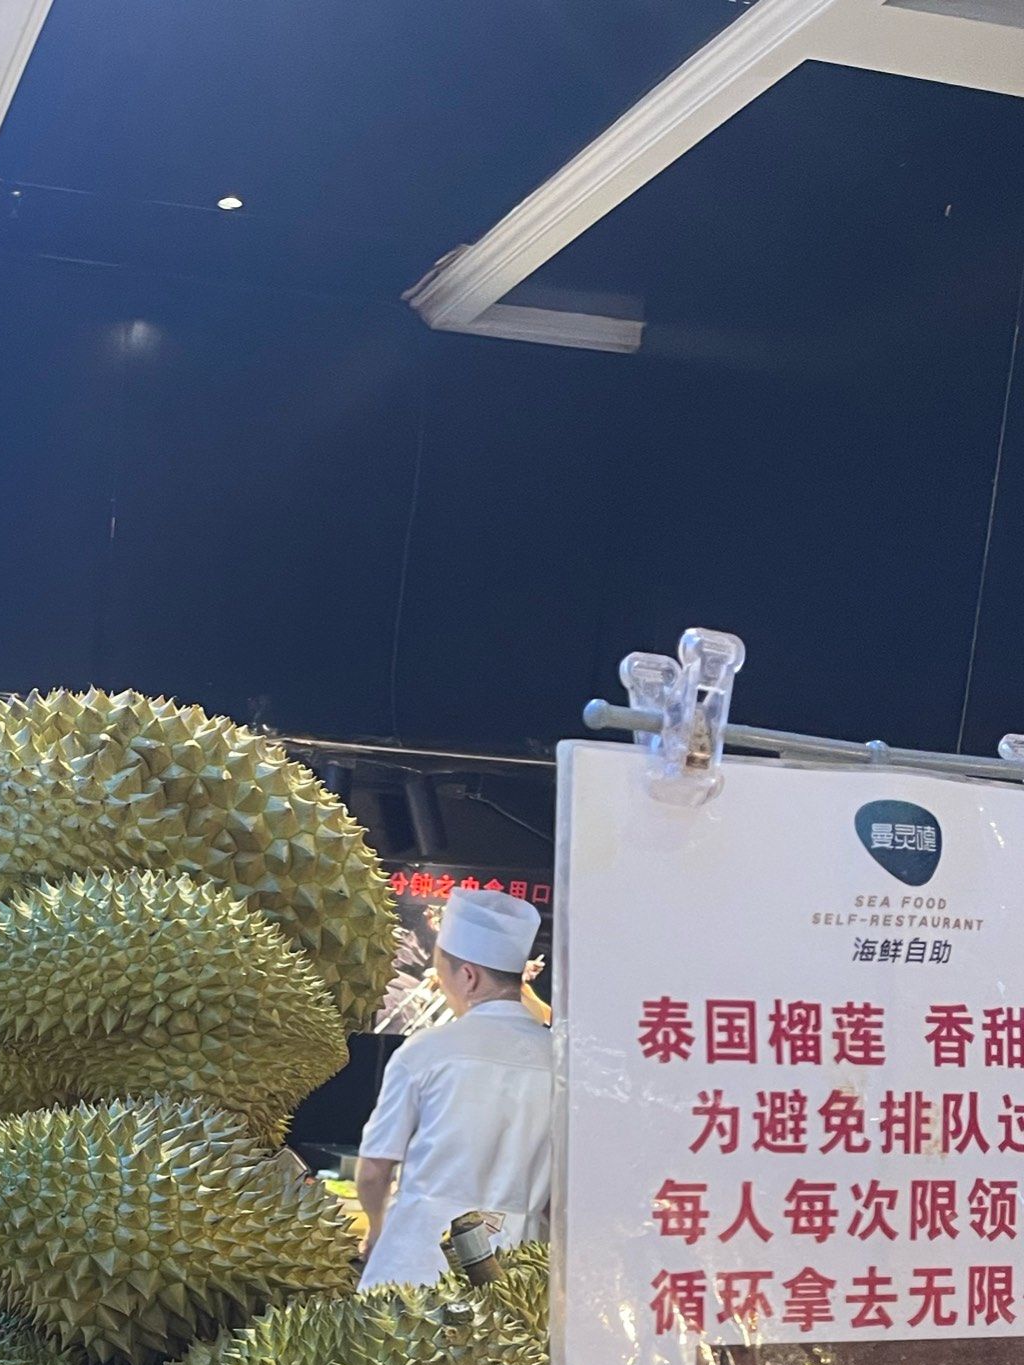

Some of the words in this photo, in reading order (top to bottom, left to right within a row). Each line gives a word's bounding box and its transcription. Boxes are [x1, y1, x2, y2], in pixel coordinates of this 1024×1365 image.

[812, 912, 985, 931] SELF-RESTAURANT
[854, 895, 891, 908] SEA
[901, 896, 948, 910] FOOD
[852, 937, 953, 965] 海鲜自助
[637, 996, 887, 1067] 泰国榴莲
[650, 1177, 1019, 1246] 每人每次限领
[648, 1264, 1024, 1335] 循环拿去无限
